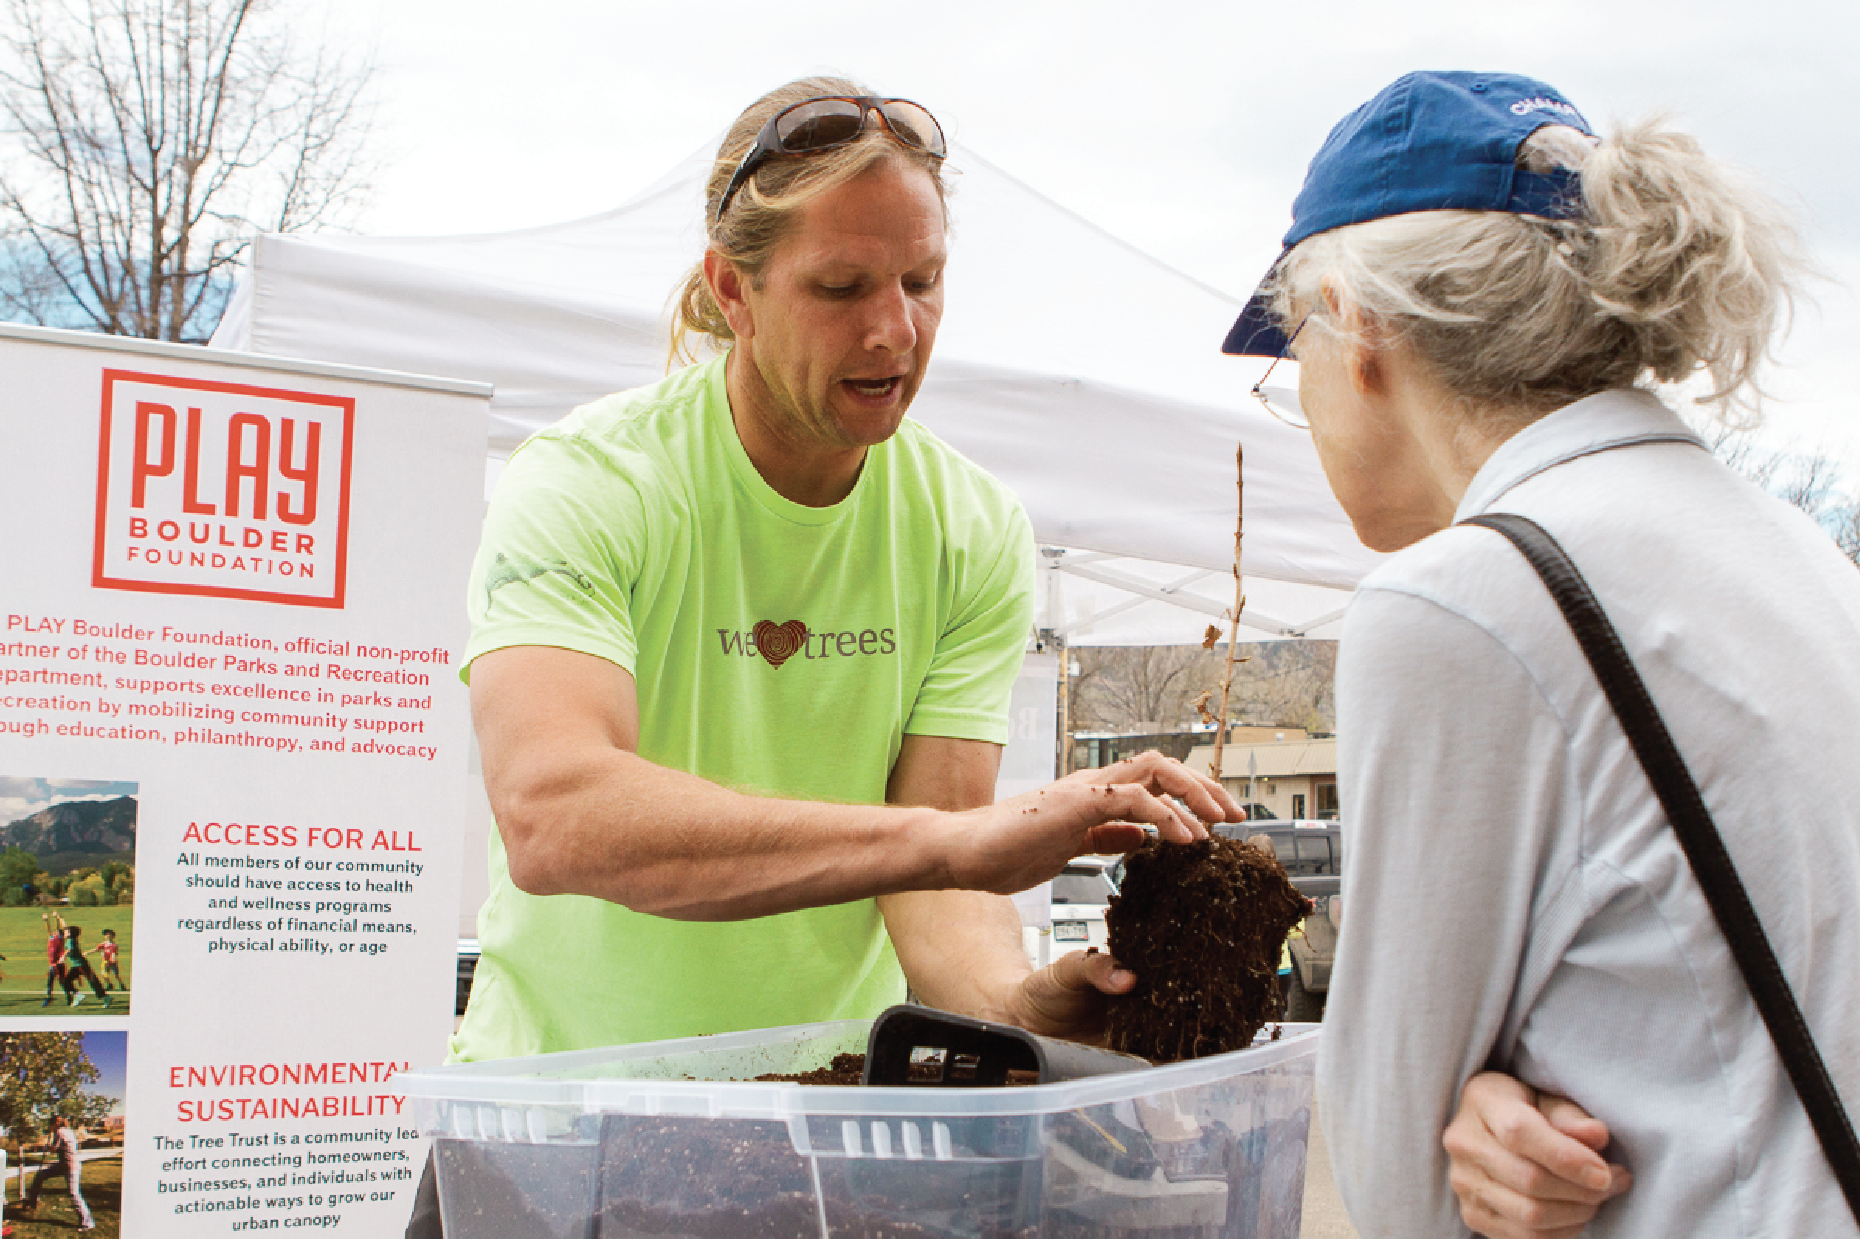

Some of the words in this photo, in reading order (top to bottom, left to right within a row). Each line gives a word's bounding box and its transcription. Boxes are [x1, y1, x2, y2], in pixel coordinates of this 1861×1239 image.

[131, 401, 321, 525] PLAY
[130, 517, 315, 555] BOULDER
[128, 547, 314, 578] FOUNDATION
[8, 615, 65, 633] PLAY
[74, 620, 153, 640] Boulder
[163, 626, 278, 651] Foundation,
[285, 637, 349, 656] official
[357, 646, 448, 664] non-profit
[716, 629, 757, 657] we
[803, 628, 896, 659] trees
[68, 645, 88, 659] of
[96, 646, 126, 664] the
[135, 650, 217, 668] Boulder
[225, 656, 278, 674] Parks
[285, 664, 319, 677] and
[327, 663, 429, 685] Recreation
[116, 679, 205, 693] supports
[212, 684, 310, 701] excellence
[318, 688, 333, 702] in
[341, 691, 392, 707] parks
[398, 696, 431, 710] and
[0, 695, 90, 712] creation
[99, 698, 121, 716] by
[129, 702, 234, 724] mobilizing
[242, 712, 347, 732] community
[355, 719, 423, 733] support
[57, 722, 166, 741] education,
[175, 727, 302, 752] philanthropy,
[310, 738, 344, 752] and
[352, 739, 436, 760] advocacy
[183, 822, 298, 846] ACCESS
[309, 828, 363, 850] FOR
[372, 831, 422, 851] ALL
[177, 853, 198, 865] All
[205, 854, 279, 868] members
[284, 856, 299, 870] of
[305, 860, 332, 870] our
[336, 860, 423, 876] community
[186, 874, 239, 888] should
[245, 876, 282, 890] have
[287, 881, 340, 891] access
[346, 881, 360, 891] to
[366, 879, 412, 893] health
[208, 896, 237, 908] and
[243, 897, 310, 910] wellness
[316, 902, 391, 915] programs
[178, 917, 262, 932] regardless
[267, 918, 282, 930] of
[288, 918, 357, 932] financial
[363, 924, 415, 935] means,
[209, 938, 274, 953] physical
[279, 938, 333, 955] ability,
[338, 943, 355, 952] or
[360, 943, 388, 955] age
[178, 1095, 405, 1122] SUSTAINABILITY
[153, 1136, 184, 1150] The
[189, 1135, 223, 1149] Tree
[229, 1133, 268, 1146] Trust
[274, 1132, 285, 1144] is
[291, 1135, 299, 1144] a
[305, 1129, 392, 1144] community
[163, 1157, 206, 1172] effort
[212, 1153, 301, 1169] connecting
[307, 1150, 409, 1164] homeowners,
[158, 1178, 251, 1192] businesses,
[257, 1174, 287, 1188] and
[293, 1169, 377, 1184] individuals
[381, 1167, 411, 1180] with
[175, 1197, 260, 1214] actionable
[265, 1197, 302, 1209] ways
[309, 1194, 322, 1205] to
[329, 1194, 366, 1208] grow
[371, 1192, 395, 1201] our
[233, 1217, 279, 1231] urban
[284, 1215, 340, 1228] canopy
